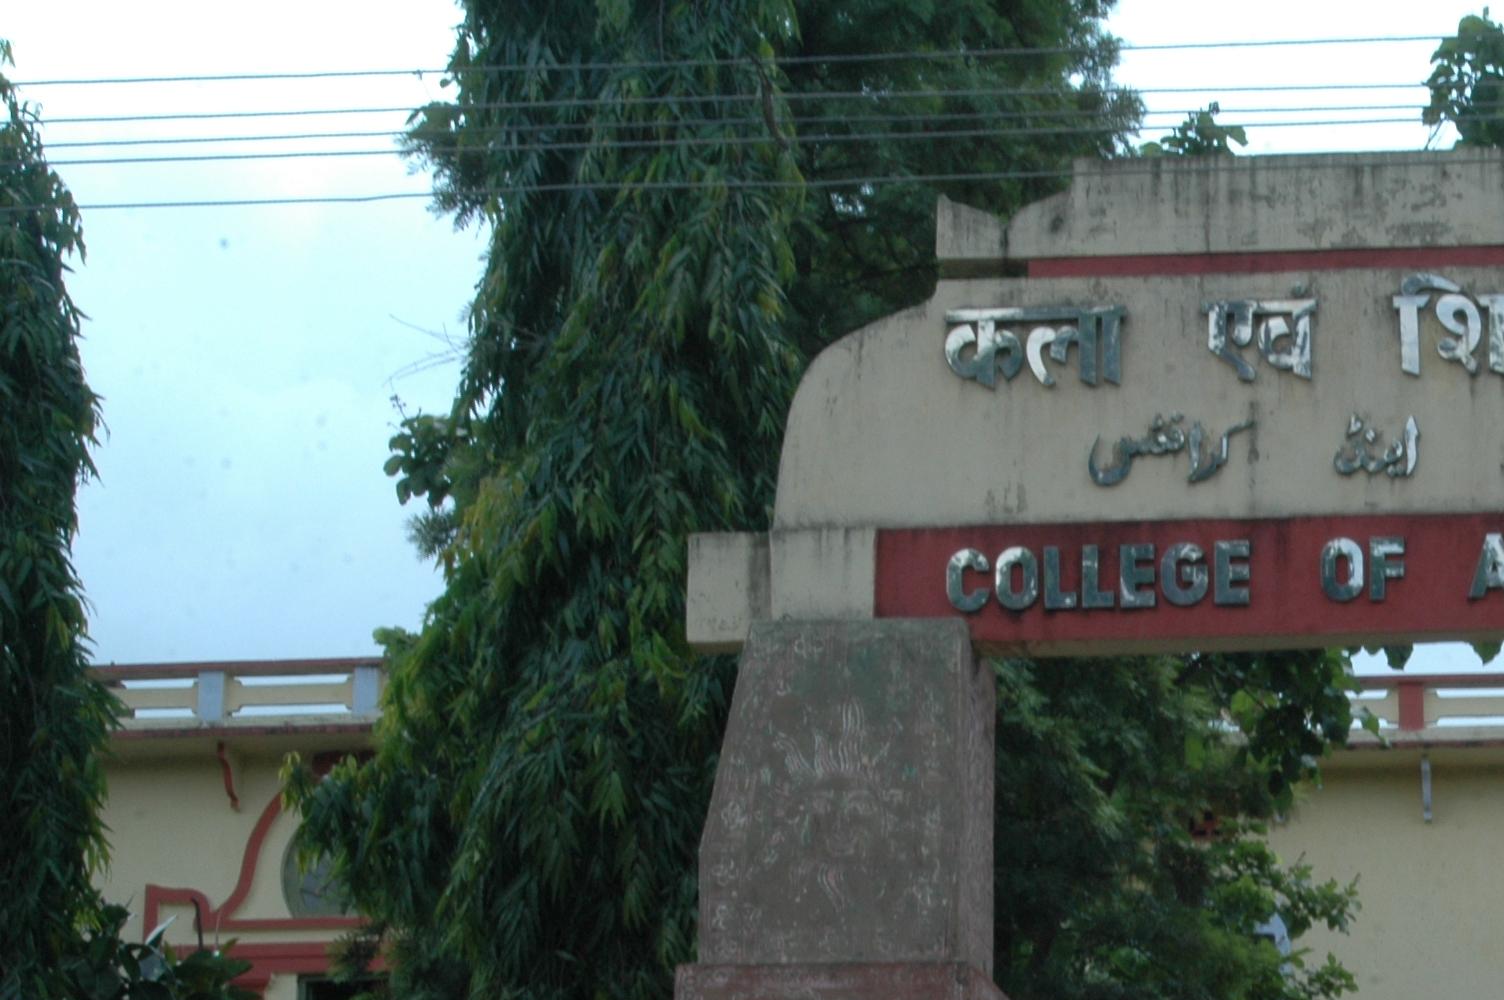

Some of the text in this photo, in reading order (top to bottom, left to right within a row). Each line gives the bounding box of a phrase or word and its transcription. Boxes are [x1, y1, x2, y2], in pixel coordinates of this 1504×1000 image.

[944, 304, 1128, 390] कला
[1201, 282, 1319, 382] एवं
[946, 539, 1252, 614] COLLEGE
[1320, 536, 1405, 603] OF
